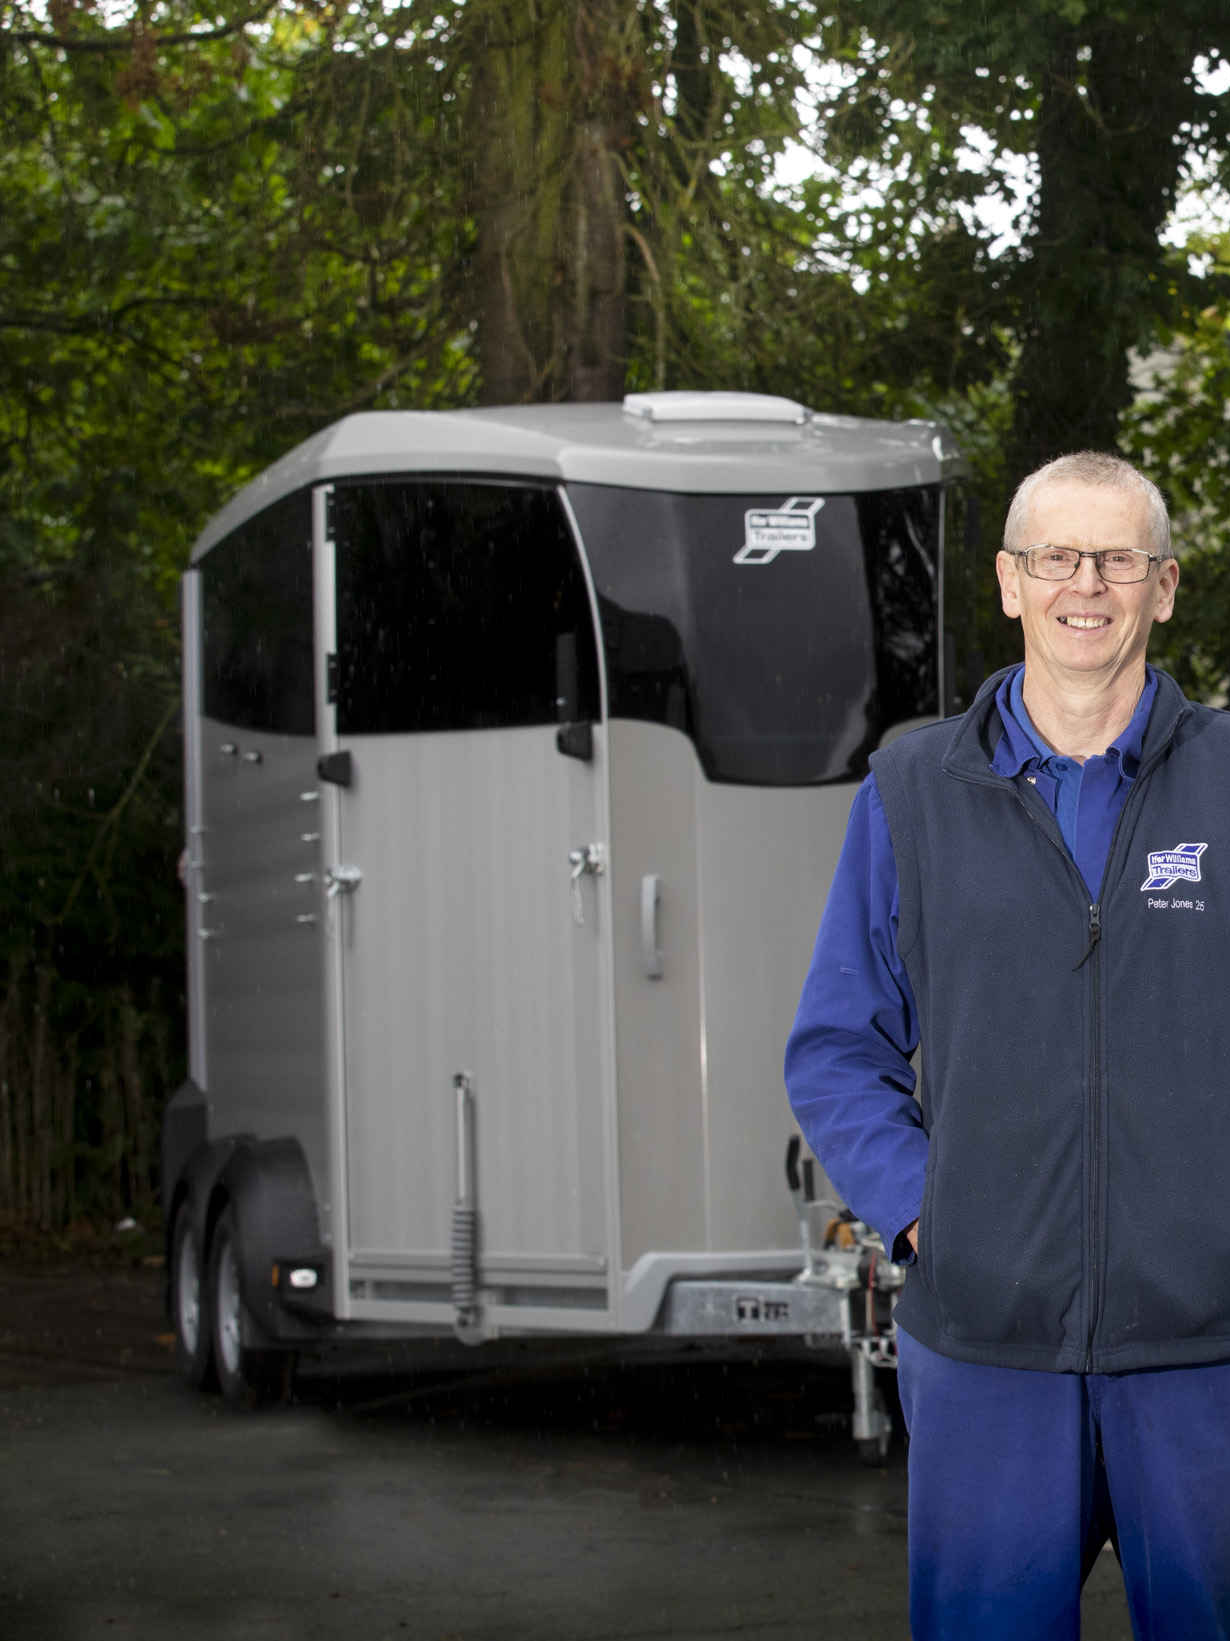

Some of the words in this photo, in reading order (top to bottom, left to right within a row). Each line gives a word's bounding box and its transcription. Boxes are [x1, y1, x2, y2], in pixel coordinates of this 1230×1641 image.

[1165, 853, 1197, 865] Williams
[1152, 865, 1197, 877] Trailers
[1147, 897, 1169, 909] Peter
[1170, 897, 1194, 909] Jones
